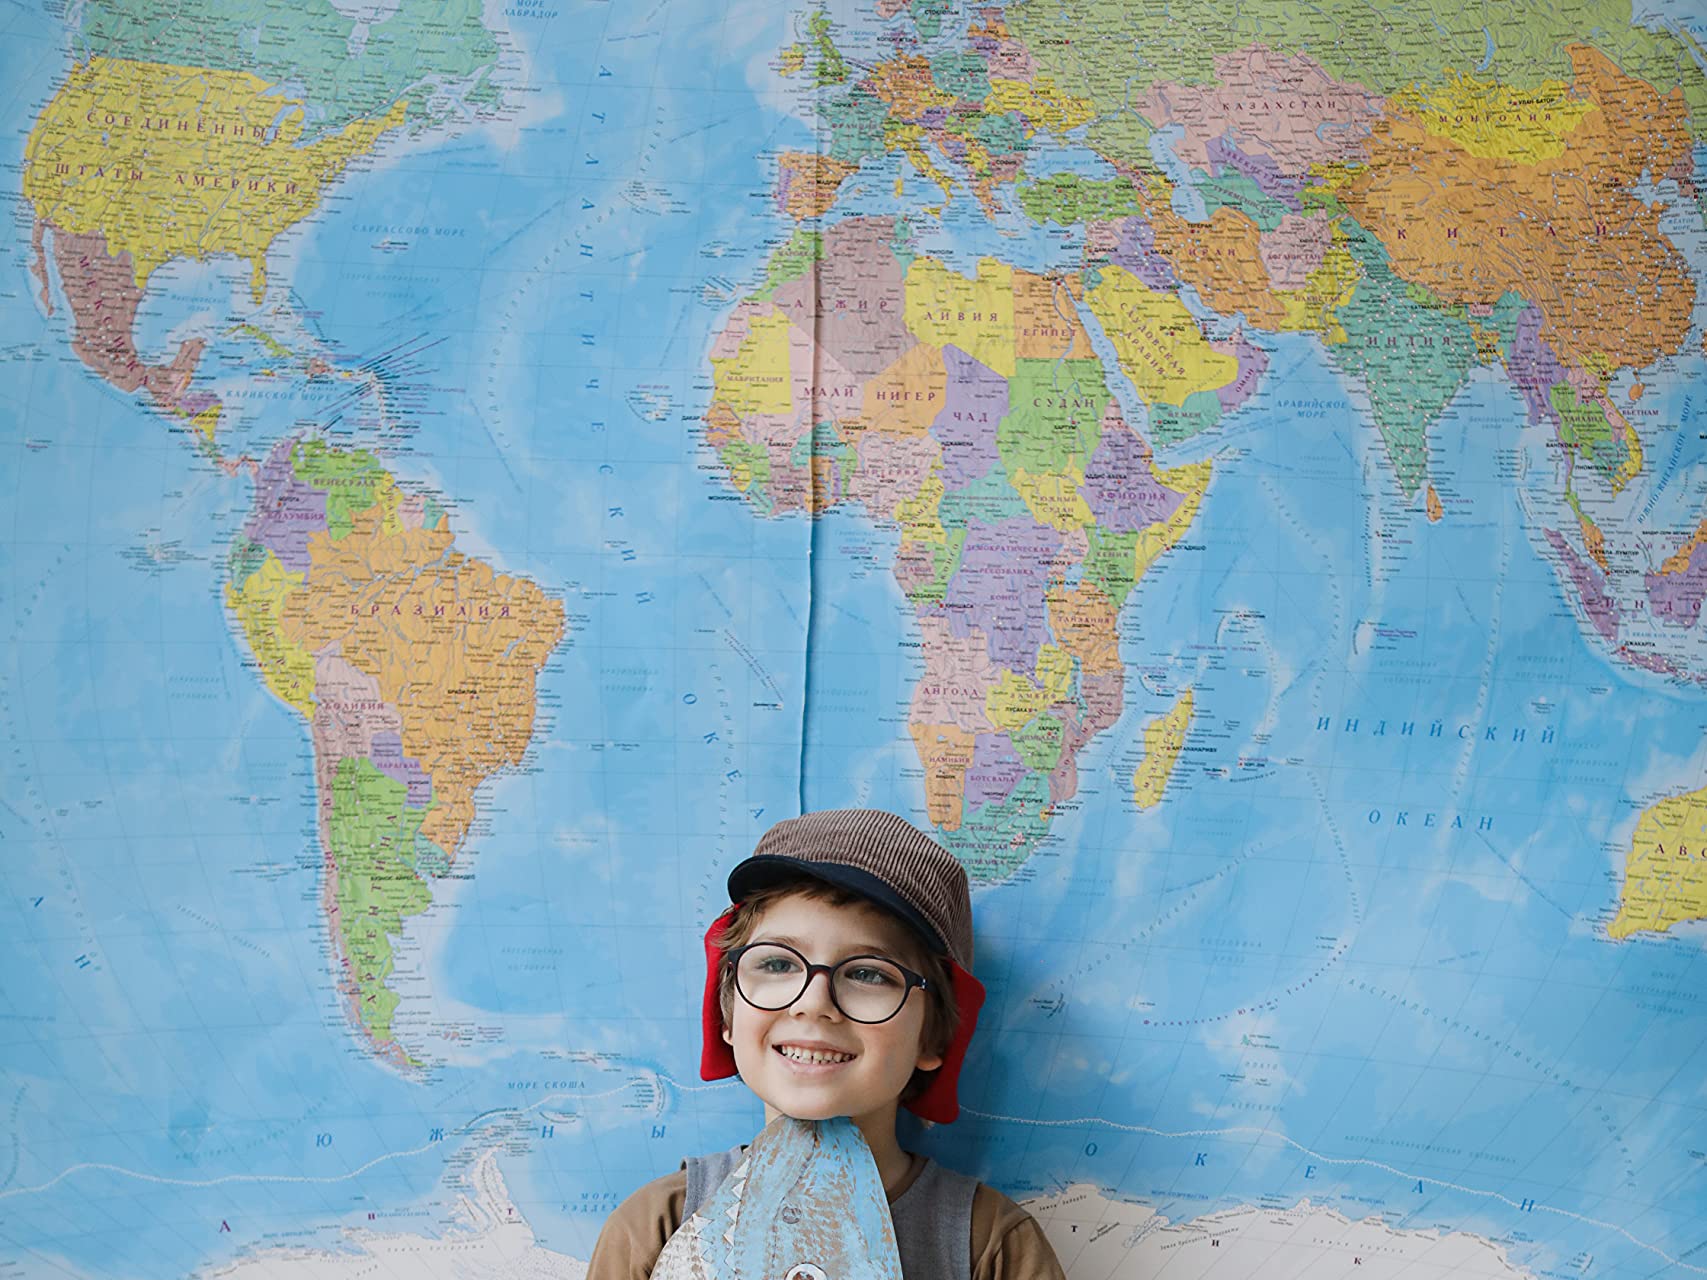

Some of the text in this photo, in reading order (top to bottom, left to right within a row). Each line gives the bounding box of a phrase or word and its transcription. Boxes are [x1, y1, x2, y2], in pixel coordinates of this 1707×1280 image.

[1222, 101, 1336, 111] КАЗАХСТАН
[1439, 113, 1552, 123] МОНГОЛИЯ
[55, 163, 297, 195] ШТАТЫ АМЕРИКИ
[434, 227, 466, 238] МОРЕ
[1397, 222, 1607, 240] КИТАЙ
[1189, 249, 1236, 257] ИРАН
[794, 299, 888, 310] АЛЖИР
[79, 255, 149, 386] МЕКСИКА
[924, 312, 998, 322] ЛИВИЯ
[1023, 328, 1078, 337] ЕГИПЕТ
[1120, 302, 1186, 375] САУДОВСКАЯ
[1369, 335, 1451, 347] ИНДИЯ
[1126, 332, 1165, 376] АРАВИЯ
[727, 375, 784, 383] МАВРИТАНИЯ
[1236, 368, 1255, 393] ОМАН
[225, 390, 293, 400] КАРИБСКОЕ
[803, 386, 854, 398] МАЛИ
[876, 391, 936, 401] НИГЕР
[1033, 398, 1094, 409] СУДАН
[1276, 400, 1346, 410] АРАВИЙСКОЕ
[953, 411, 988, 423] ЧАД
[1297, 410, 1327, 418] МОРЕ
[1622, 409, 1659, 417] ВЬЕТНАМ
[580, 65, 656, 604] АТЛАНТИЧЕСКИЙ
[682, 693, 765, 820] ОКЕА
[1637, 432, 1687, 525] ЮЖНО-КИТАЙСКОЕ
[1680, 394, 1693, 424] МОРЕ
[1096, 490, 1166, 501] ЭФИОПИЯ
[350, 604, 511, 618] БРАЗИЛИЯ
[923, 687, 980, 698] АНГОЛА
[324, 702, 385, 711] БОЛИВИЯ
[1316, 716, 1556, 744] ИНДИЙСКИЙ
[929, 756, 971, 765] НАМИБИЯ
[970, 775, 1016, 784] БОТСВАНА
[1369, 808, 1494, 830] ОКЕАН
[508, 1081, 586, 1089] МОРЕ СКОША
[315, 1125, 1536, 1212] ЮЖНЫ ОКЕАН
